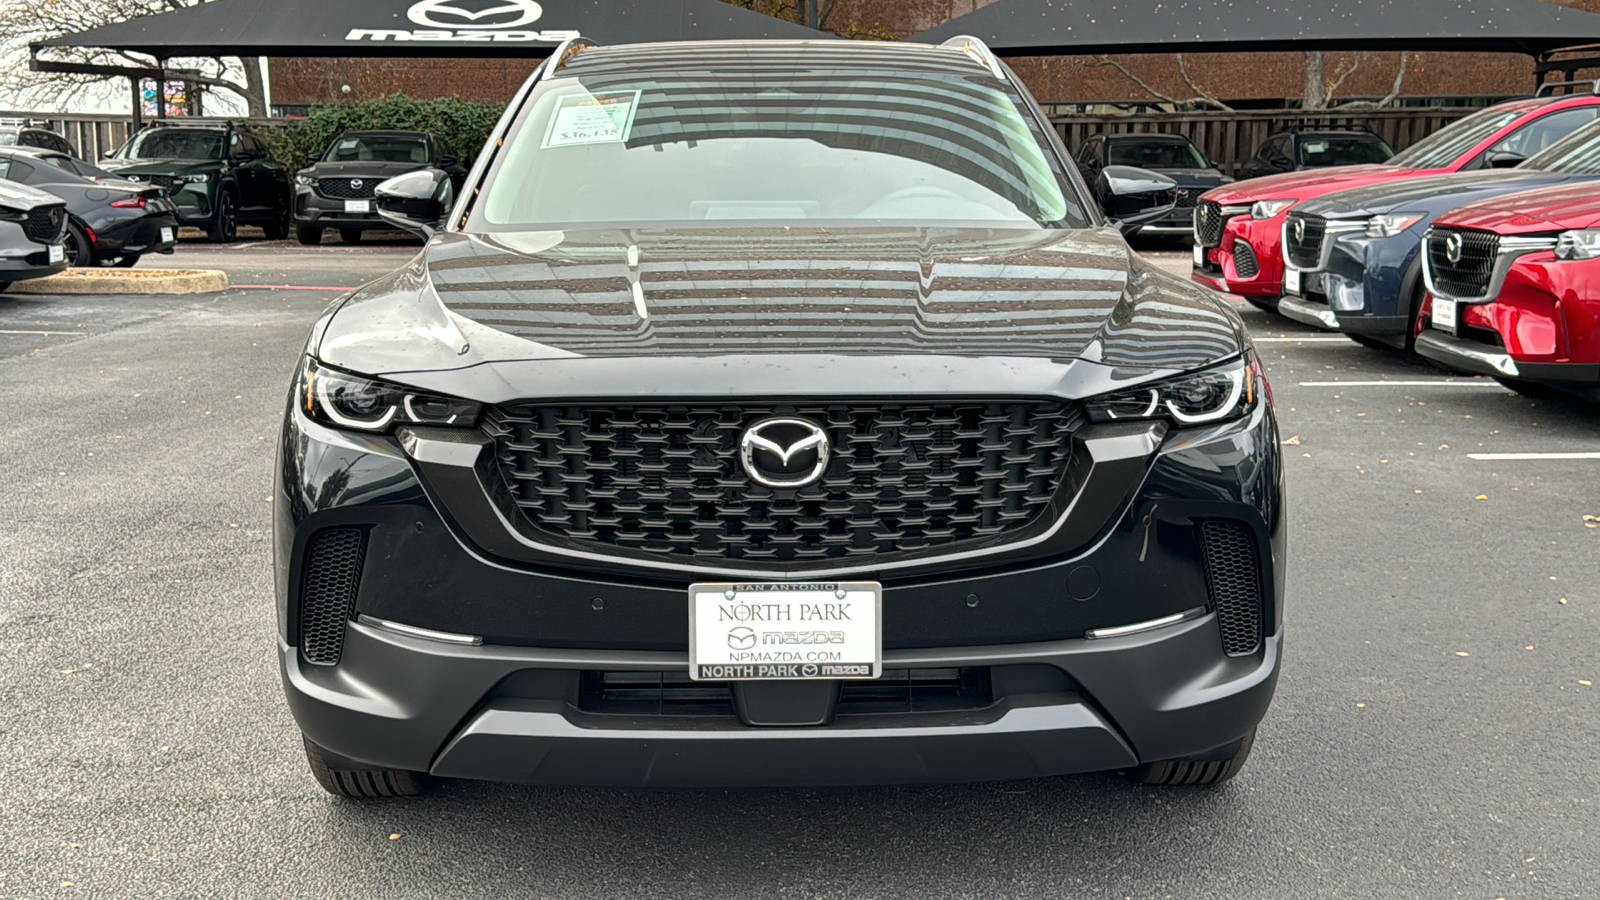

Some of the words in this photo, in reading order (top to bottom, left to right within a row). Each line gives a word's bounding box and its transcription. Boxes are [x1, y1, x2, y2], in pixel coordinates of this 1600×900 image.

[345, 28, 580, 41] mazda
[771, 583, 835, 591] ANTONIO
[718, 604, 792, 621] NORTH
[799, 603, 852, 620] PARK
[762, 630, 845, 645] mazda
[729, 651, 841, 662] NPMAZDA.COM
[702, 665, 754, 678] NORTH
[758, 664, 799, 677] PARK
[822, 664, 869, 675] mazda
